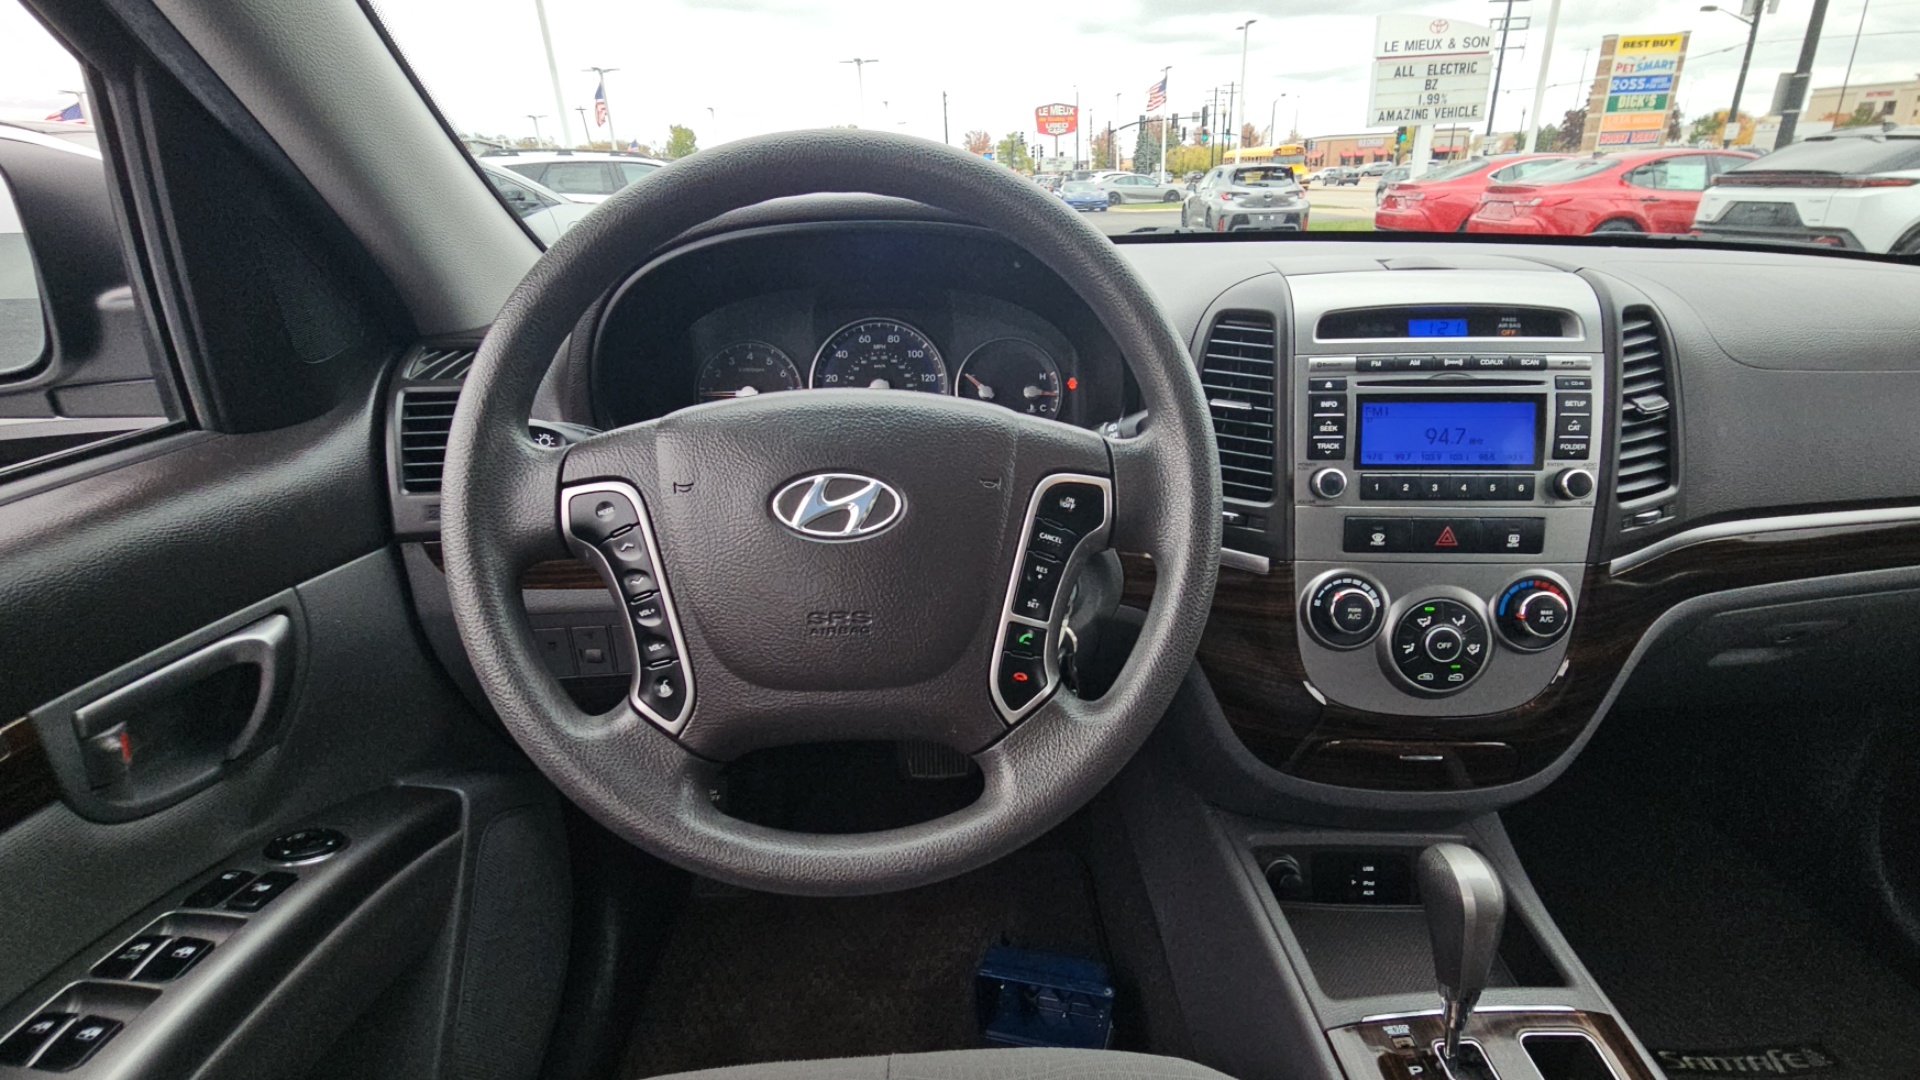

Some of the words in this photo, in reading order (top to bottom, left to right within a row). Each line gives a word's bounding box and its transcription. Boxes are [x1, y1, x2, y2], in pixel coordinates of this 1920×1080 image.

[1384, 41, 1399, 52] LE
[1404, 38, 1443, 51] MIEUX
[1447, 37, 1457, 49] &
[1462, 36, 1490, 49] SON
[1622, 40, 1650, 49] BEST
[1652, 38, 1677, 48] BUY
[1394, 65, 1415, 78] ALL
[1427, 61, 1478, 76] ELECTRIC
[1425, 78, 1439, 91] BZ
[1611, 78, 1647, 91] ROSS
[1418, 93, 1448, 106] 1.99%
[1618, 94, 1657, 108] DICK'S
[1038, 108, 1048, 116] LE
[1378, 108, 1429, 122] AMAZING
[1434, 105, 1478, 119] VEHICLE
[858, 335, 871, 344] 60
[887, 335, 900, 344] 80
[746, 352, 754, 361] 4
[835, 350, 848, 359] 40
[907, 350, 924, 359] 100
[765, 358, 774, 366] 5
[780, 370, 787, 378] 6
[825, 374, 838, 382] 20
[920, 373, 936, 382] 120
[1039, 404, 1047, 412] C
[1568, 424, 1580, 432] CAT
[1425, 427, 1467, 445] 94.7
[1374, 483, 1380, 491] 1
[1402, 483, 1410, 491] 2
[1432, 483, 1439, 492] 3
[1460, 483, 1468, 492] 4
[1489, 484, 1497, 492] 5
[1517, 483, 1525, 492] 6
[597, 506, 615, 516] MODE
[1038, 532, 1063, 544] CANCEL
[1036, 565, 1048, 574] RES
[1027, 600, 1039, 609] SET
[806, 611, 873, 625] SRS
[809, 626, 871, 636] AIRBAG
[1436, 641, 1452, 649] OFF
[1408, 1065, 1424, 1076] P
